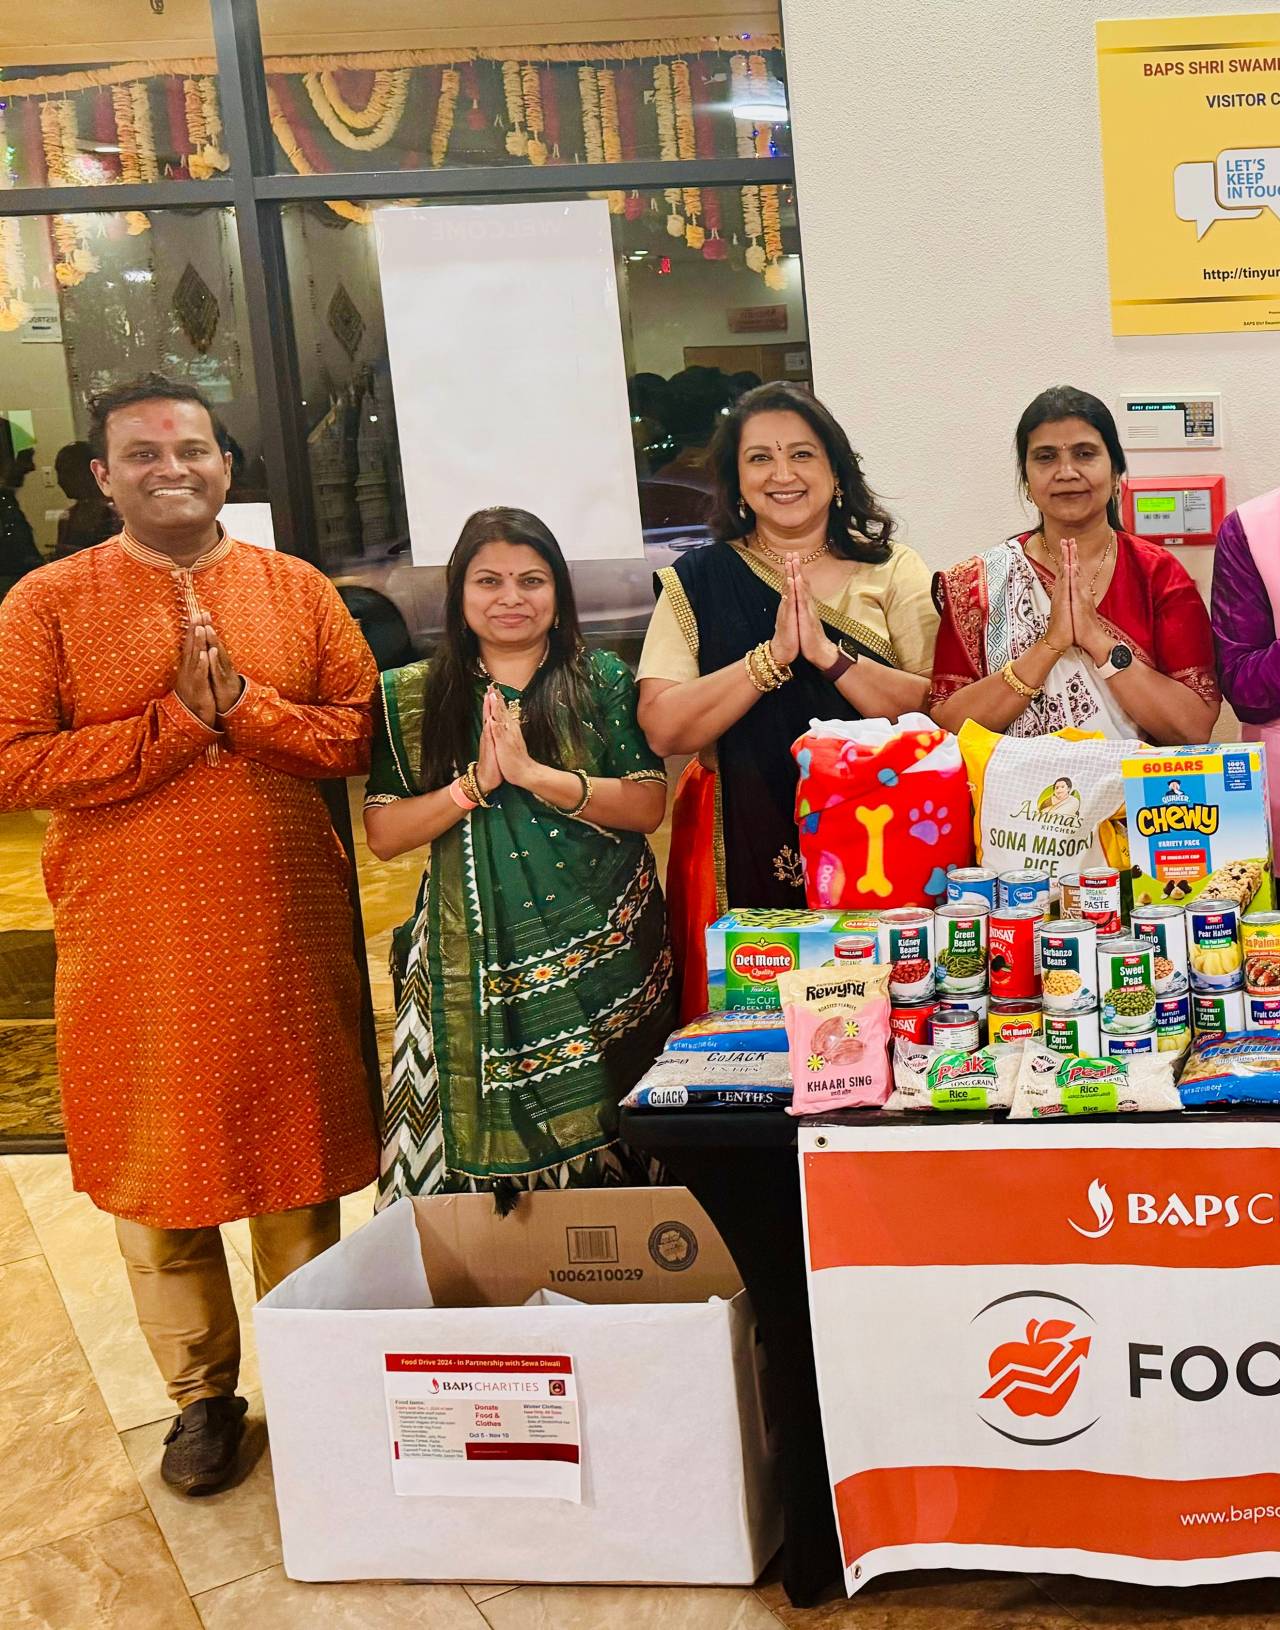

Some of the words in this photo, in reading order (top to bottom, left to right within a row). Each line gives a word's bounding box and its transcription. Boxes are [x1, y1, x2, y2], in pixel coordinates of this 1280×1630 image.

[1143, 61, 1185, 77] BAPS
[1188, 60, 1225, 75] SHRI
[1206, 92, 1267, 109] VISITOR
[1226, 158, 1266, 173] LET'S
[1226, 172, 1264, 186] KEEP
[1227, 186, 1243, 199] IN
[1142, 762, 1163, 774] 60
[1163, 760, 1204, 773] BARS
[989, 828, 1028, 852] SONA
[1084, 900, 1110, 910] PASTE
[954, 930, 975, 939] Green
[989, 926, 1017, 944] NDSAY
[953, 939, 976, 947] Beans
[735, 954, 755, 966] Del
[755, 954, 791, 966] Monte
[1046, 957, 1067, 966] Beans
[751, 968, 775, 977] Quality
[1119, 964, 1145, 976] Sweet
[1123, 976, 1143, 986] Peas
[805, 981, 866, 1001] Rewynd
[756, 996, 777, 1005] CUT
[1051, 1036, 1067, 1044] Corn
[937, 1055, 987, 1082] Peak
[1068, 1064, 1121, 1081] Peak
[807, 1078, 846, 1093] KHAARI
[849, 1075, 873, 1087] SING
[1079, 1085, 1099, 1094] Rice
[949, 1090, 969, 1099] Rice
[1128, 1192, 1241, 1228] BAPS
[550, 1268, 644, 1283] 1006210029
[401, 1358, 417, 1367] Food
[418, 1358, 436, 1367] Drive
[436, 1359, 452, 1367] 2024
[464, 1359, 504, 1369] Partnership
[521, 1360, 539, 1368] Sewa
[443, 1381, 474, 1392] BAPS
[474, 1381, 540, 1393] CHARITIES
[474, 1403, 499, 1411] Donate
[475, 1411, 493, 1419] Food
